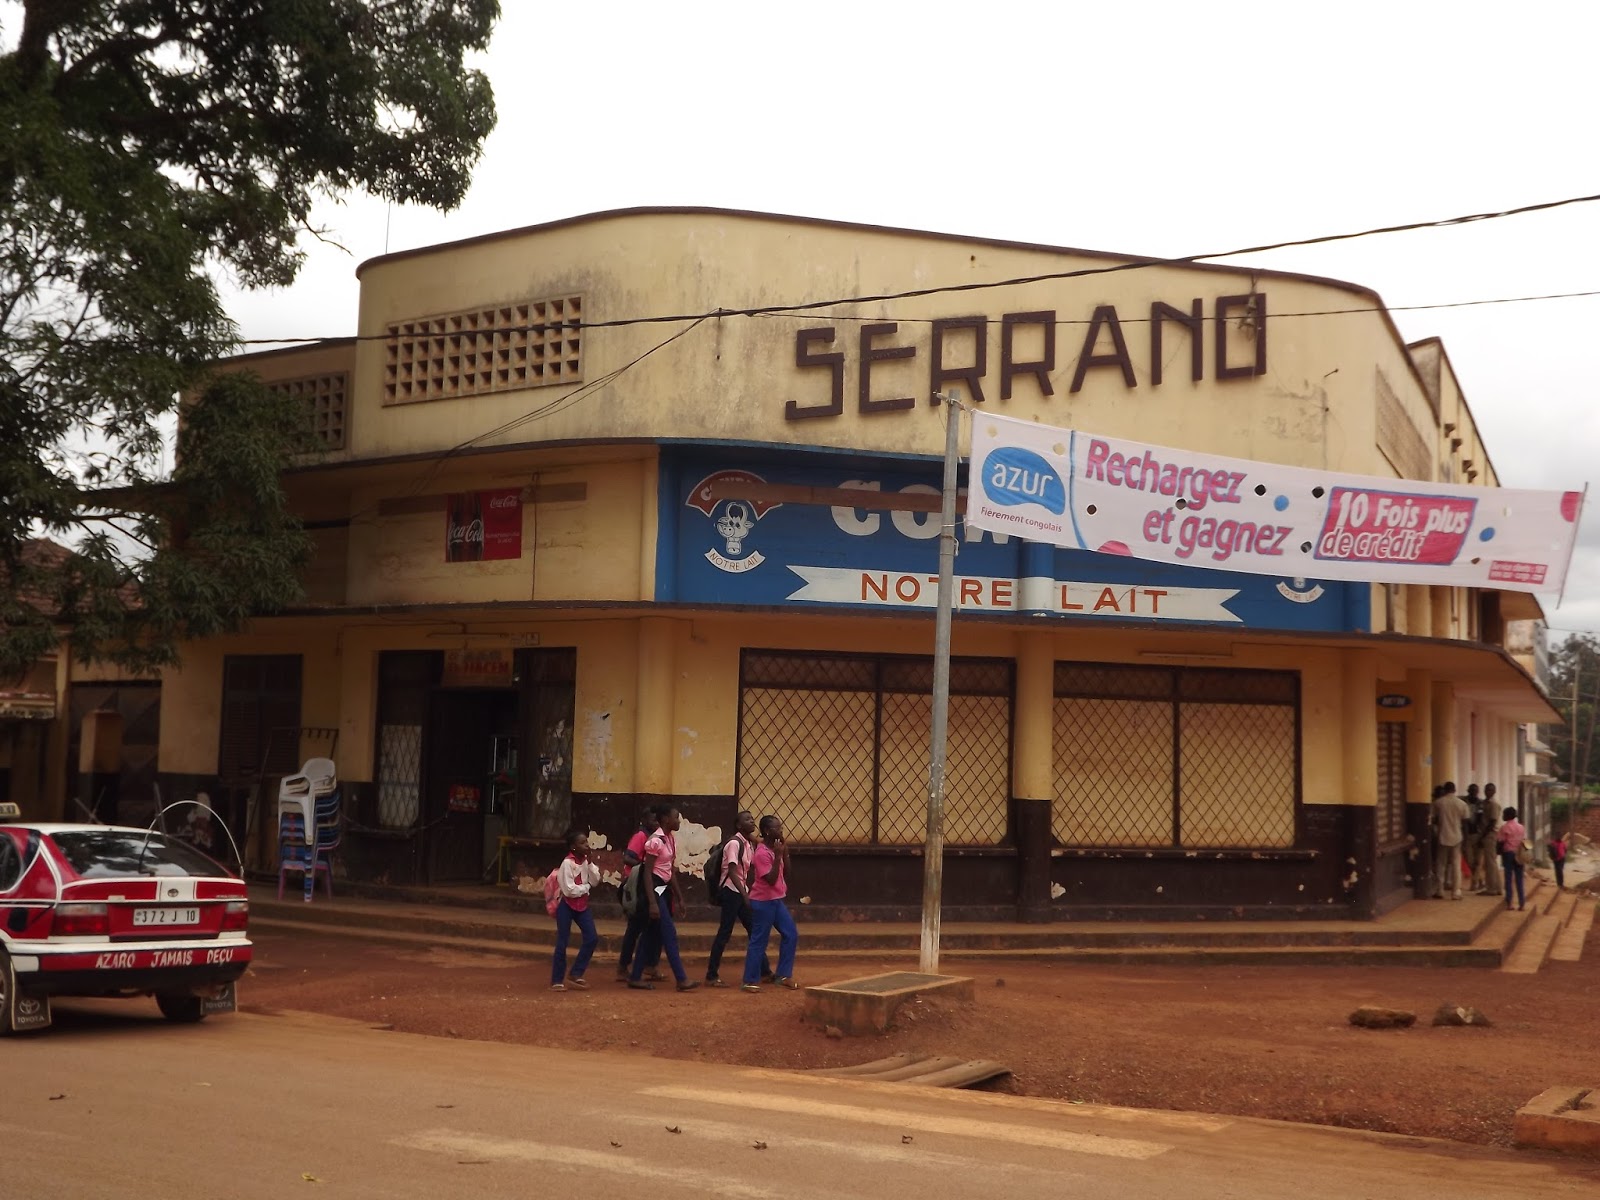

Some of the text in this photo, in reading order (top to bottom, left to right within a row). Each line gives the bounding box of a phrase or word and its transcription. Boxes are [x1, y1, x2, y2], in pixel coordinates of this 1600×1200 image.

[785, 293, 1266, 421] SERRANO
[991, 463, 1053, 498] azur
[1085, 439, 1247, 510] Rechargez
[1025, 518, 1062, 533] congolais
[1336, 491, 1471, 537] 10 Fois plus
[1143, 507, 1293, 561] et gagnez
[1319, 526, 1426, 560] de crédit
[710, 552, 758, 571] NOTRE LAIT
[861, 573, 1168, 614] NORE LAIT
[142, 911, 165, 923] 372
[172, 911, 177, 922] J
[186, 910, 196, 922] 10
[95, 952, 136, 969] AZARO
[150, 949, 194, 968] JAMAIS
[17, 1015, 45, 1024] TOYOTA
[205, 1001, 232, 1009] TOYOTA
